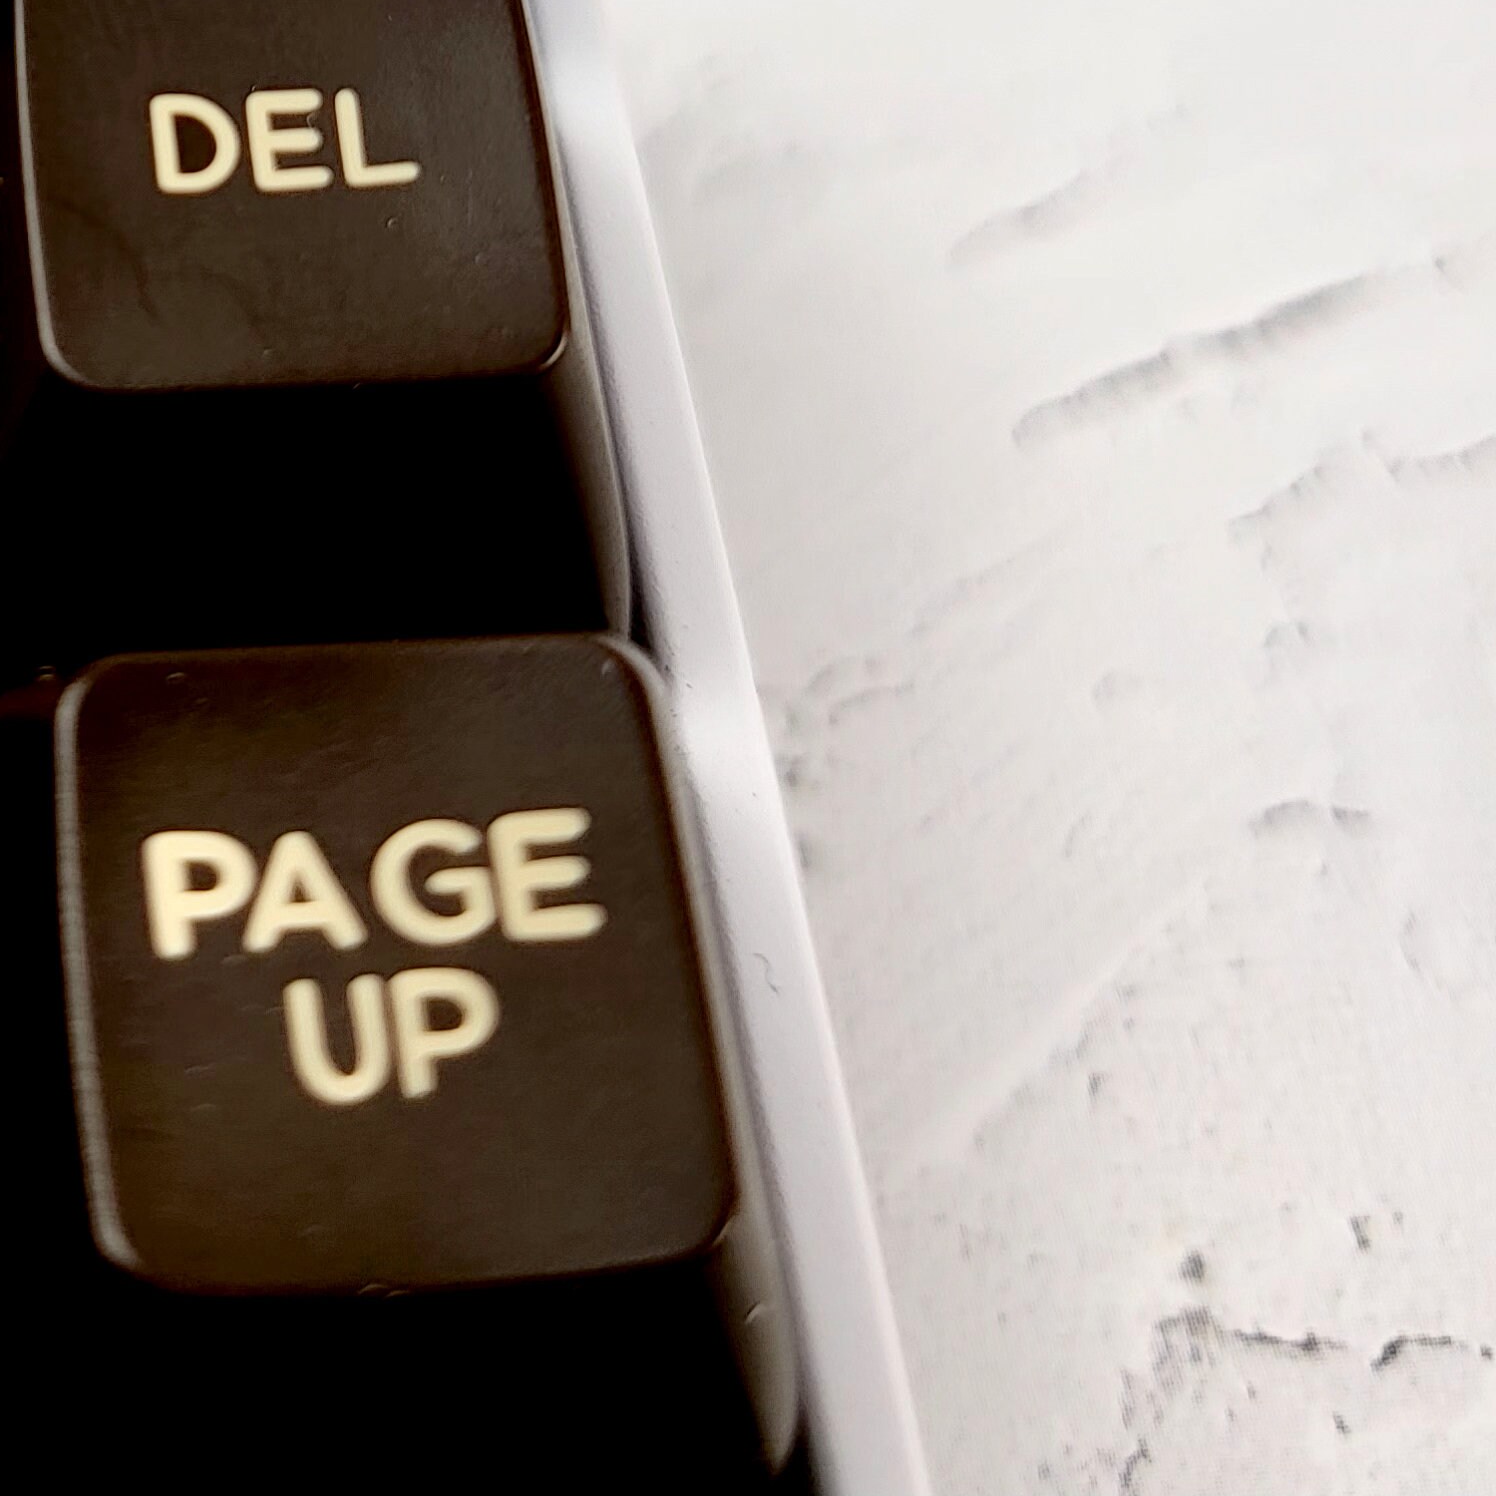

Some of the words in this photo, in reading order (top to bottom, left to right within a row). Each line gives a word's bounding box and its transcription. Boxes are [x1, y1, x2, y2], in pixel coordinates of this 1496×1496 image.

[148, 87, 421, 194] DEL
[142, 806, 607, 961] PAGE
[282, 967, 499, 1106] UP
